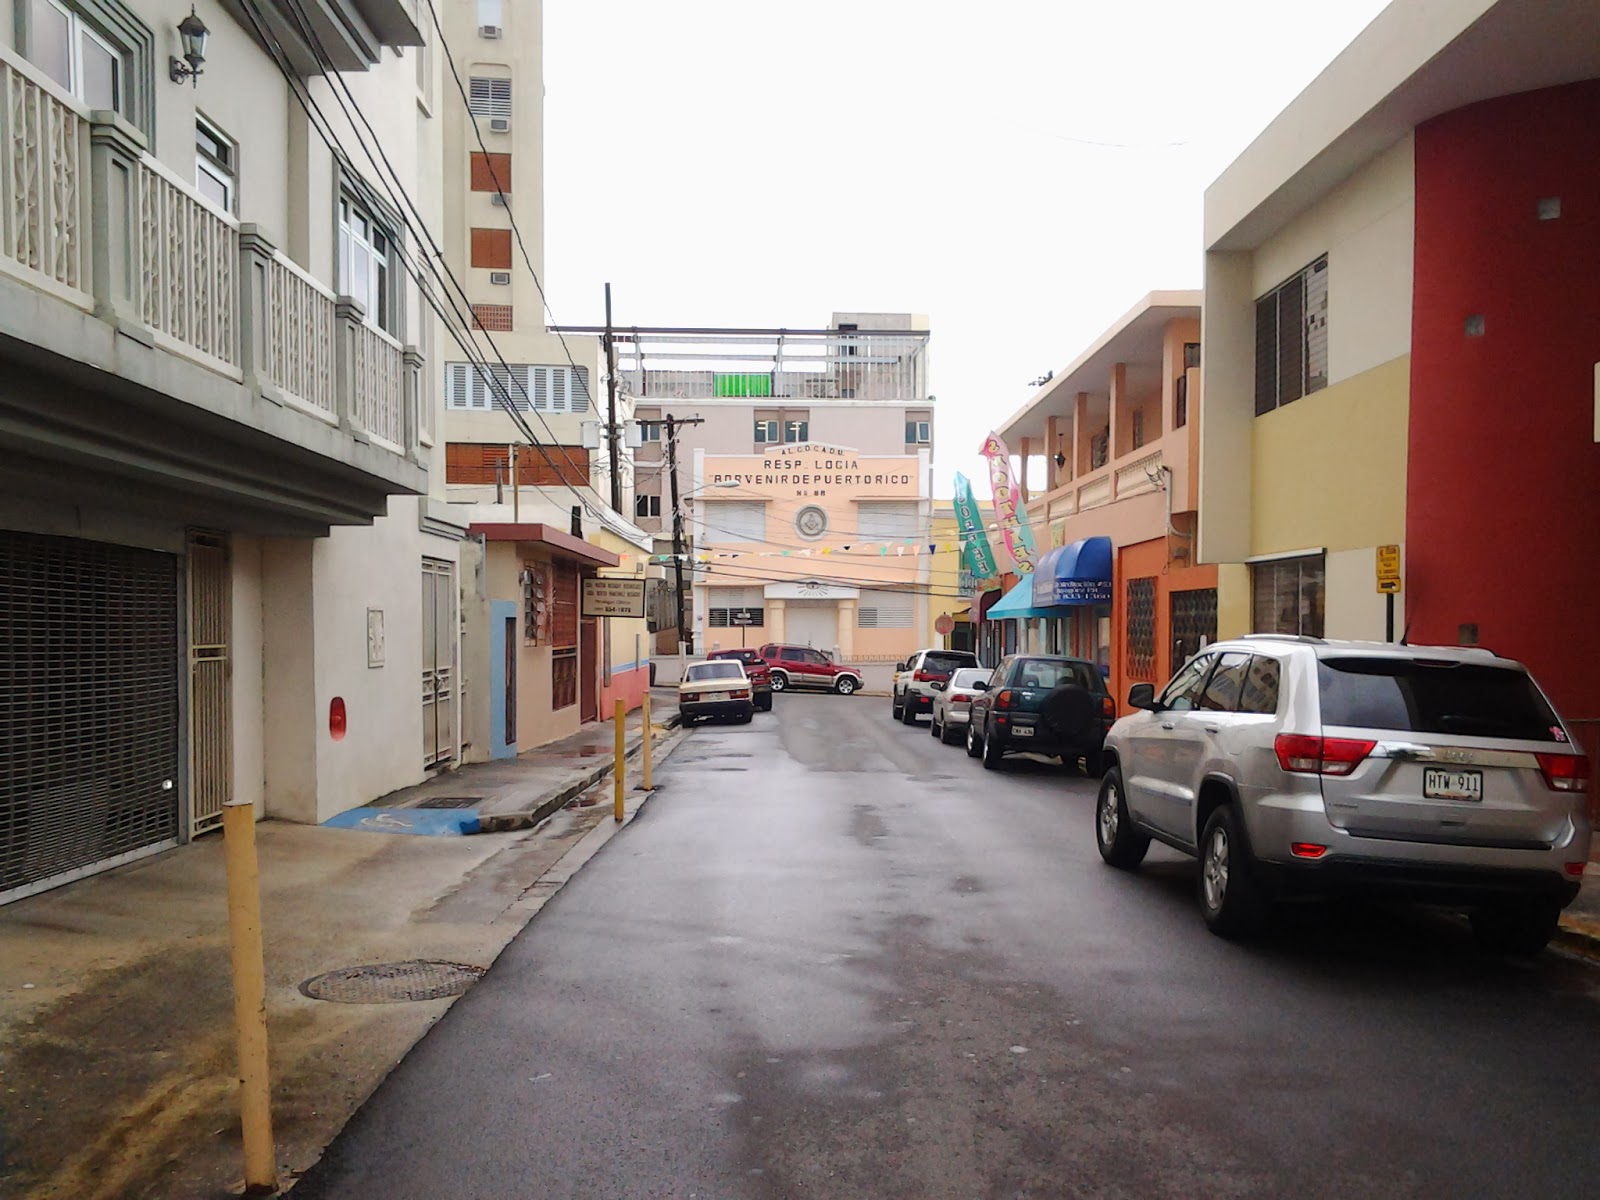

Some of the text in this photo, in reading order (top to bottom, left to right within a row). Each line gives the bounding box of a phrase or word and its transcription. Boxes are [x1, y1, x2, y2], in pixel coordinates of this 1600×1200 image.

[814, 474, 871, 485] PUERTO
[1429, 775, 1479, 792] HTW 911
